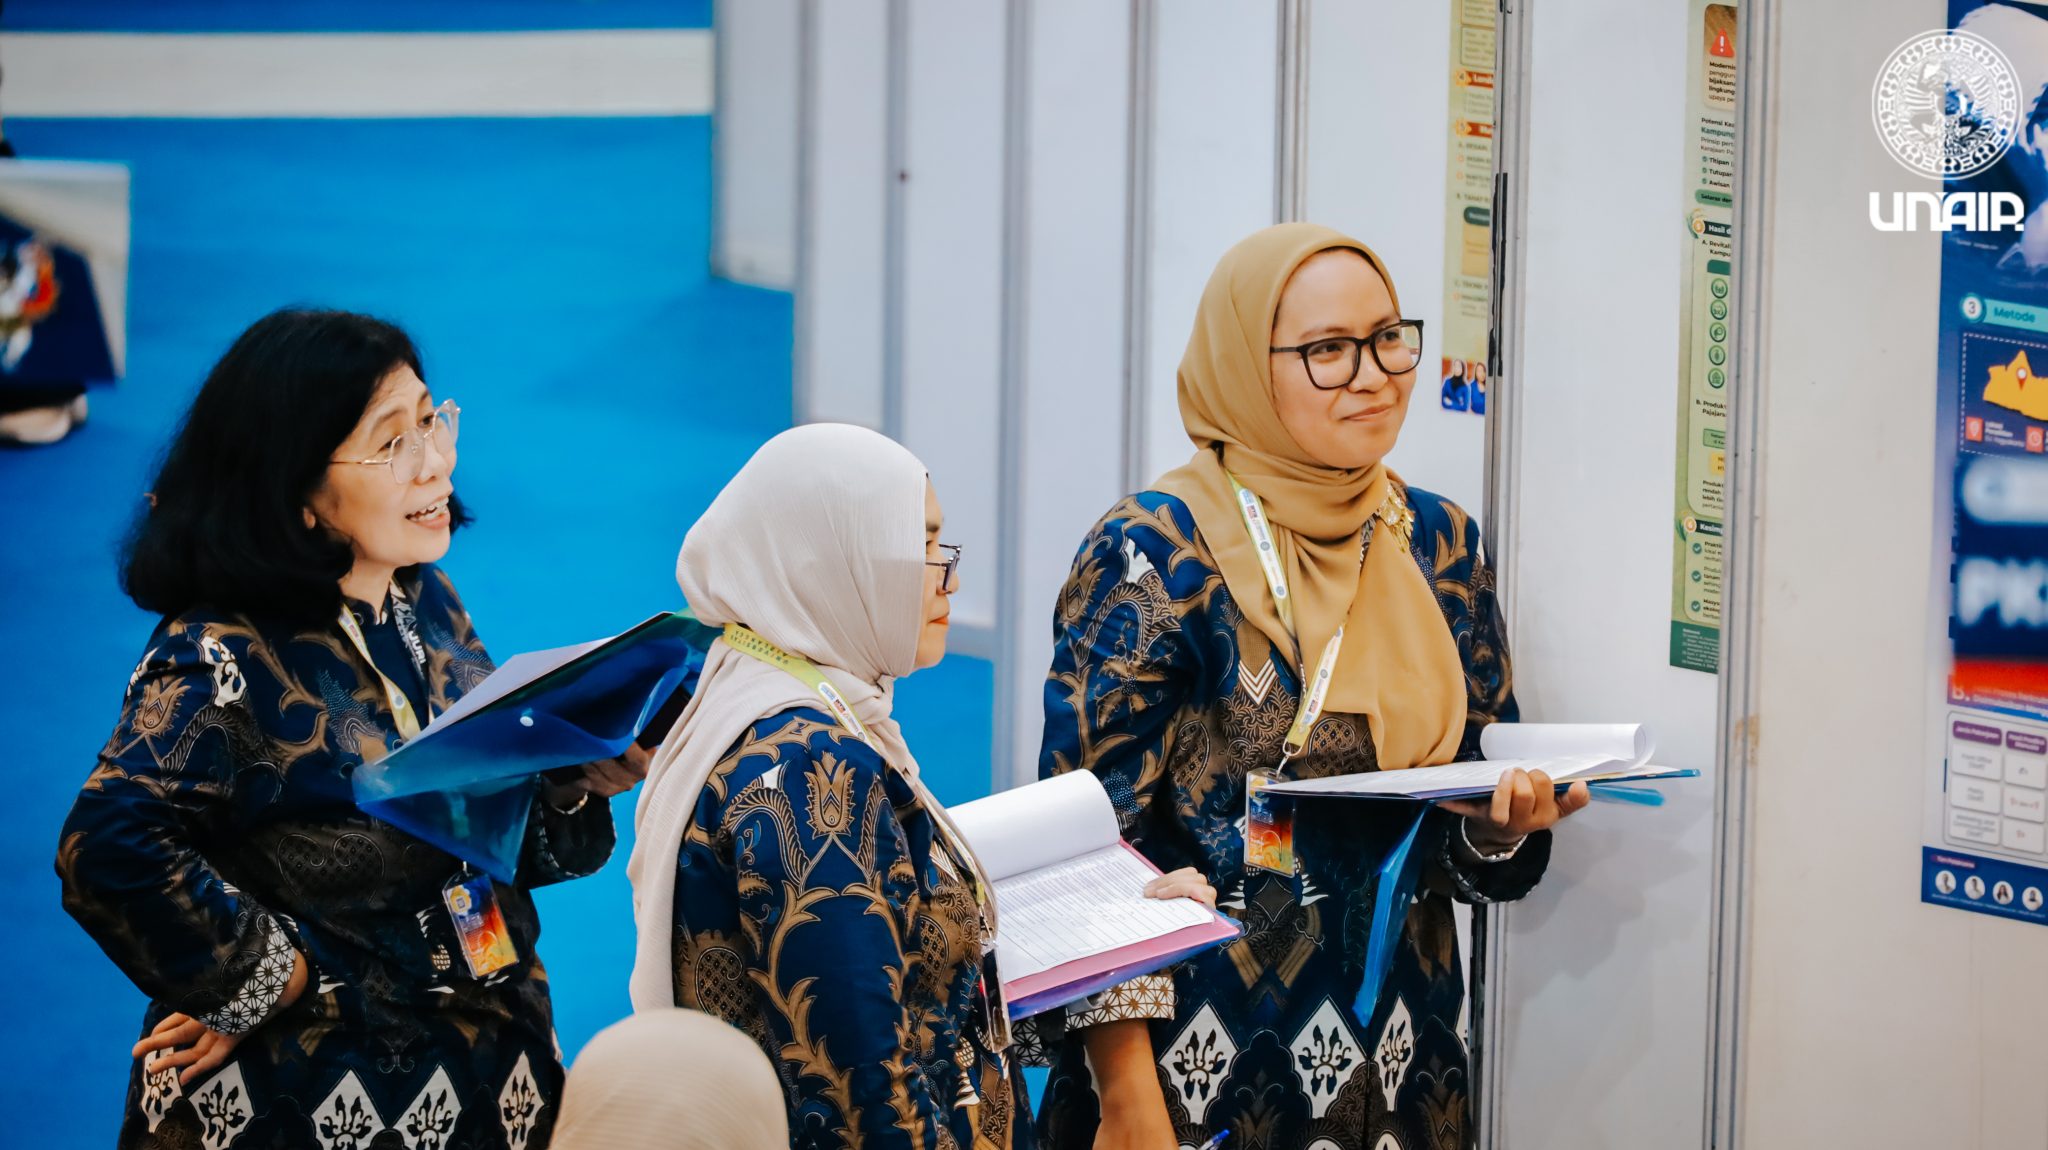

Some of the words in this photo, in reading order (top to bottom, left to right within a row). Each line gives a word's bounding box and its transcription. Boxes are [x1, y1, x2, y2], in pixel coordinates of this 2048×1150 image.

[1709, 225, 1726, 234] Hasil
[1968, 302, 1976, 314] 3
[1994, 307, 2036, 323] Metode
[408, 631, 427, 664] JURI
